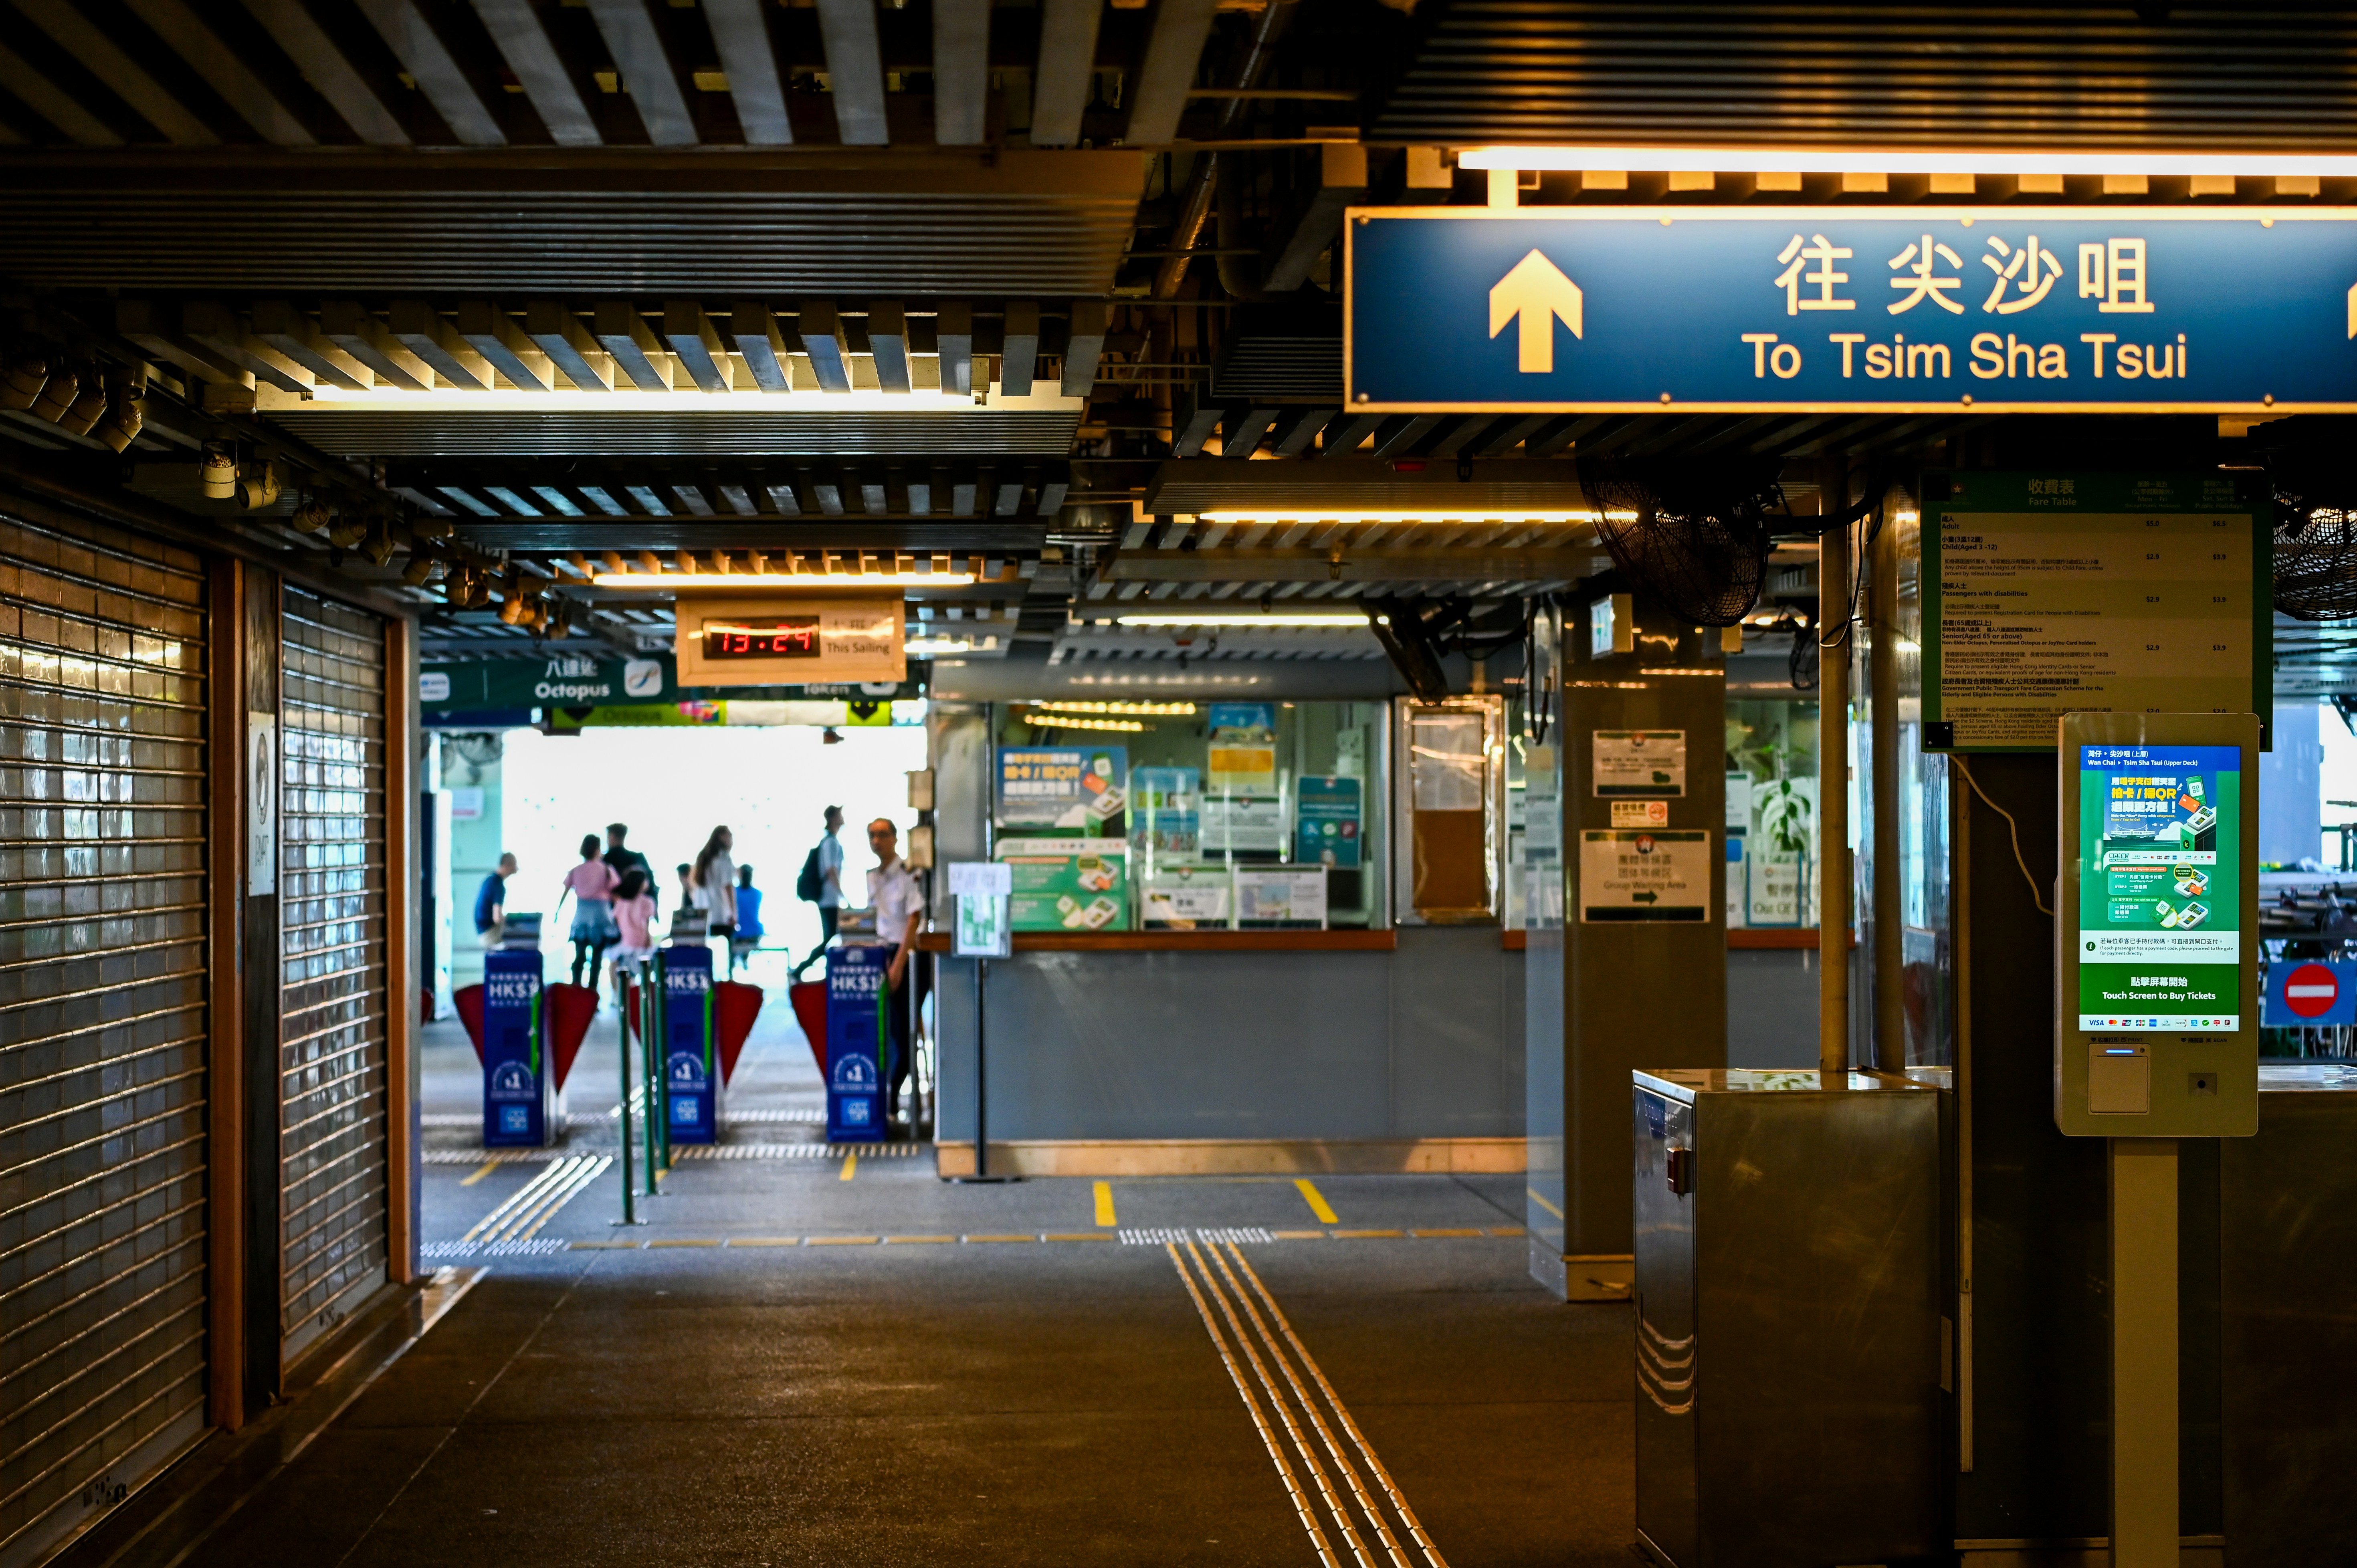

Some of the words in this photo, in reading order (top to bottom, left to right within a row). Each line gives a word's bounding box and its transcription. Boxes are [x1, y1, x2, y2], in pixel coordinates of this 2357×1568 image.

[1741, 333, 1801, 378] To
[1829, 333, 1951, 378] Tsim
[1969, 333, 2068, 379] Sha
[2080, 334, 2186, 379] Tsui
[2029, 479, 2075, 495] 收費表
[2029, 497, 2048, 506] Fare
[2053, 497, 2076, 506] Table
[827, 642, 849, 653] This
[852, 642, 891, 656] Sailing
[534, 681, 611, 702] Octopus
[2088, 750, 2102, 758] 灣仔
[2110, 750, 2130, 758] 尖沙咀
[2132, 750, 2149, 758] (上層)
[2131, 977, 2187, 987] 點擊屏幕開始
[2102, 991, 2127, 999] Touch
[2169, 992, 2185, 1002] Buy
[2187, 991, 2216, 1000] Tickets
